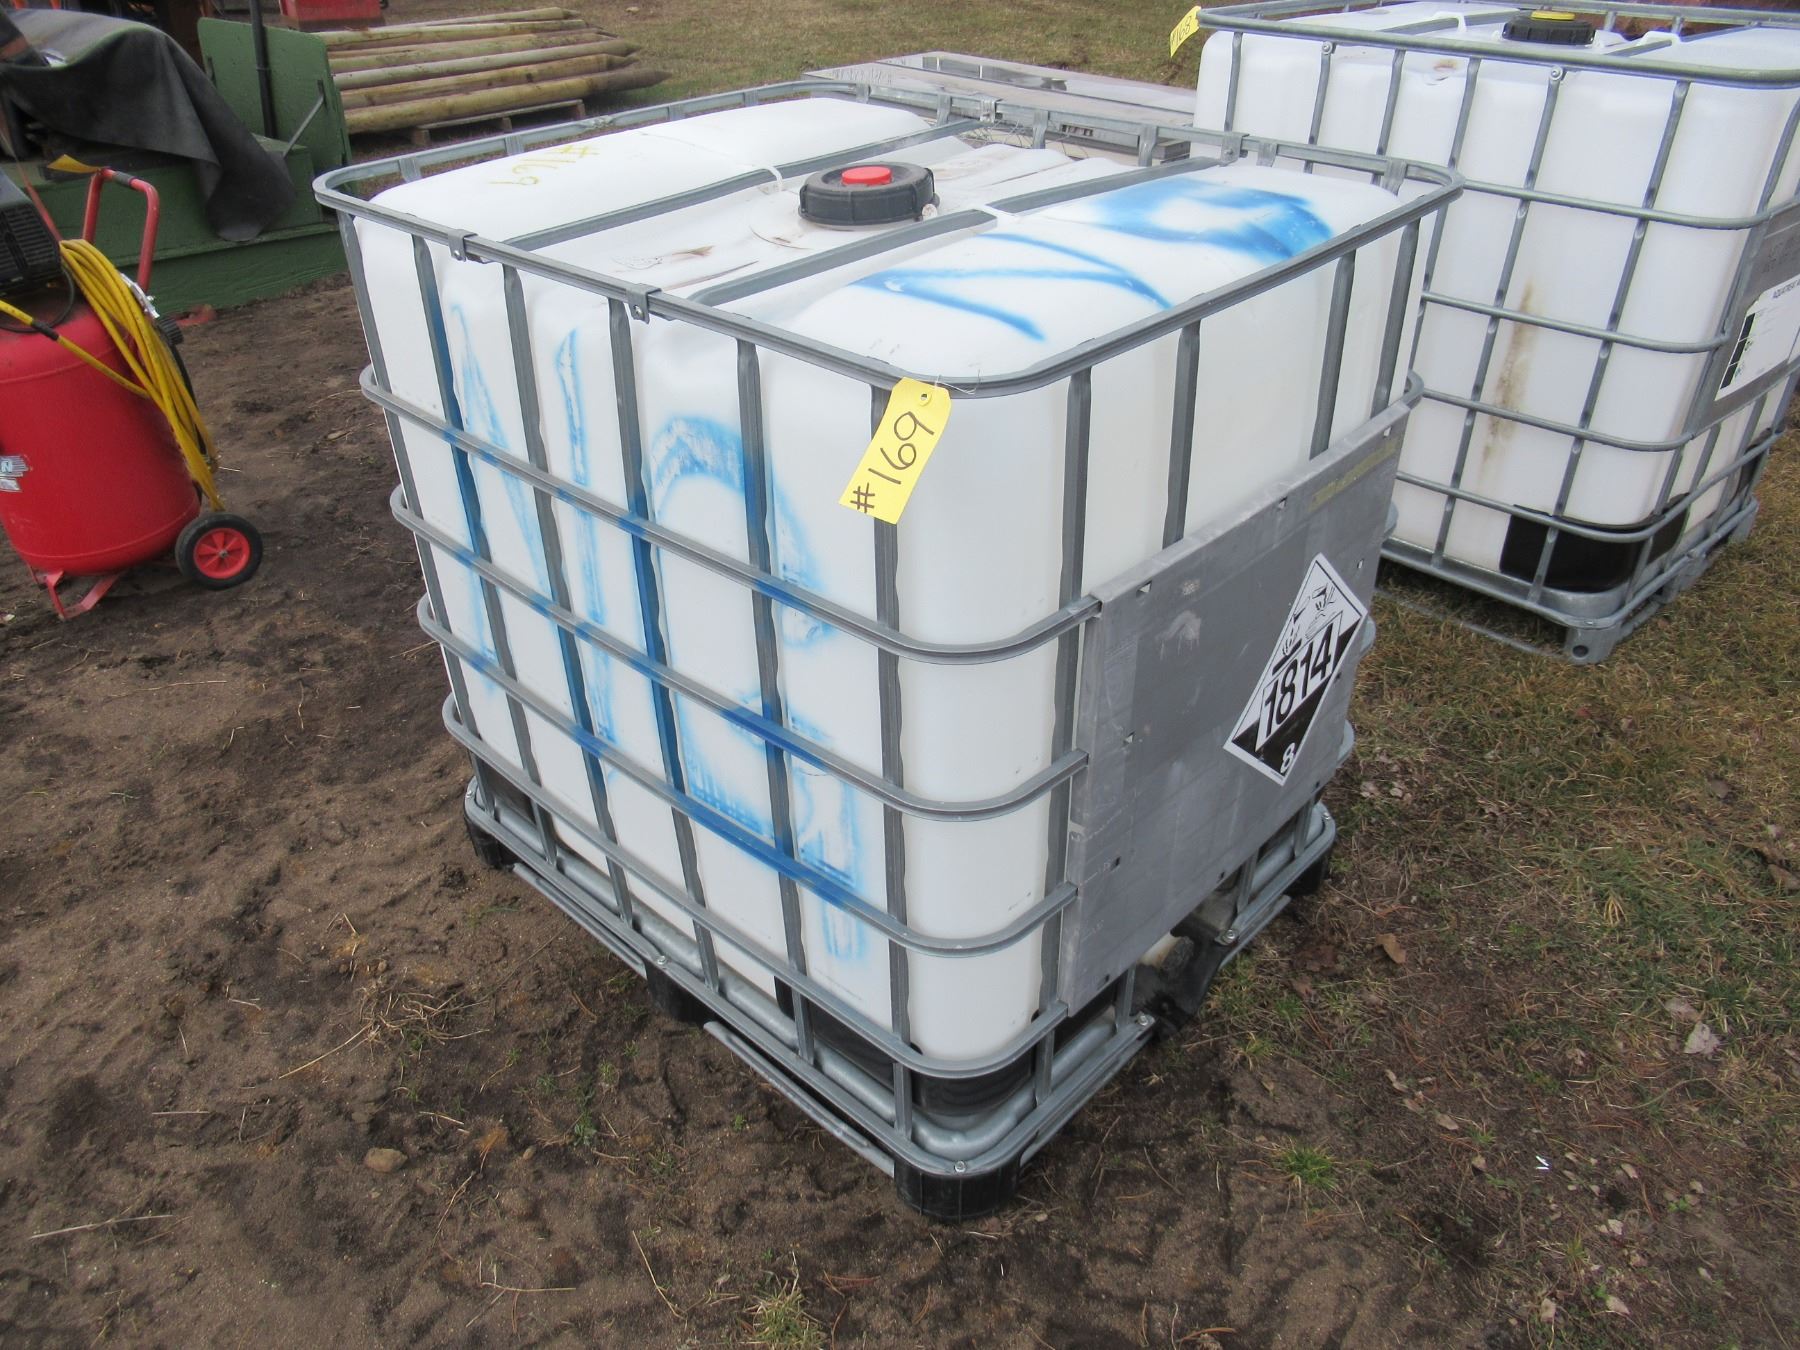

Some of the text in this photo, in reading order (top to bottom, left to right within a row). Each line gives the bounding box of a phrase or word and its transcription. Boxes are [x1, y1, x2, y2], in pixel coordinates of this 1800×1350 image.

[850, 411, 935, 514] #169
[1264, 622, 1334, 738] 1814
[1280, 742, 1296, 774] 8
